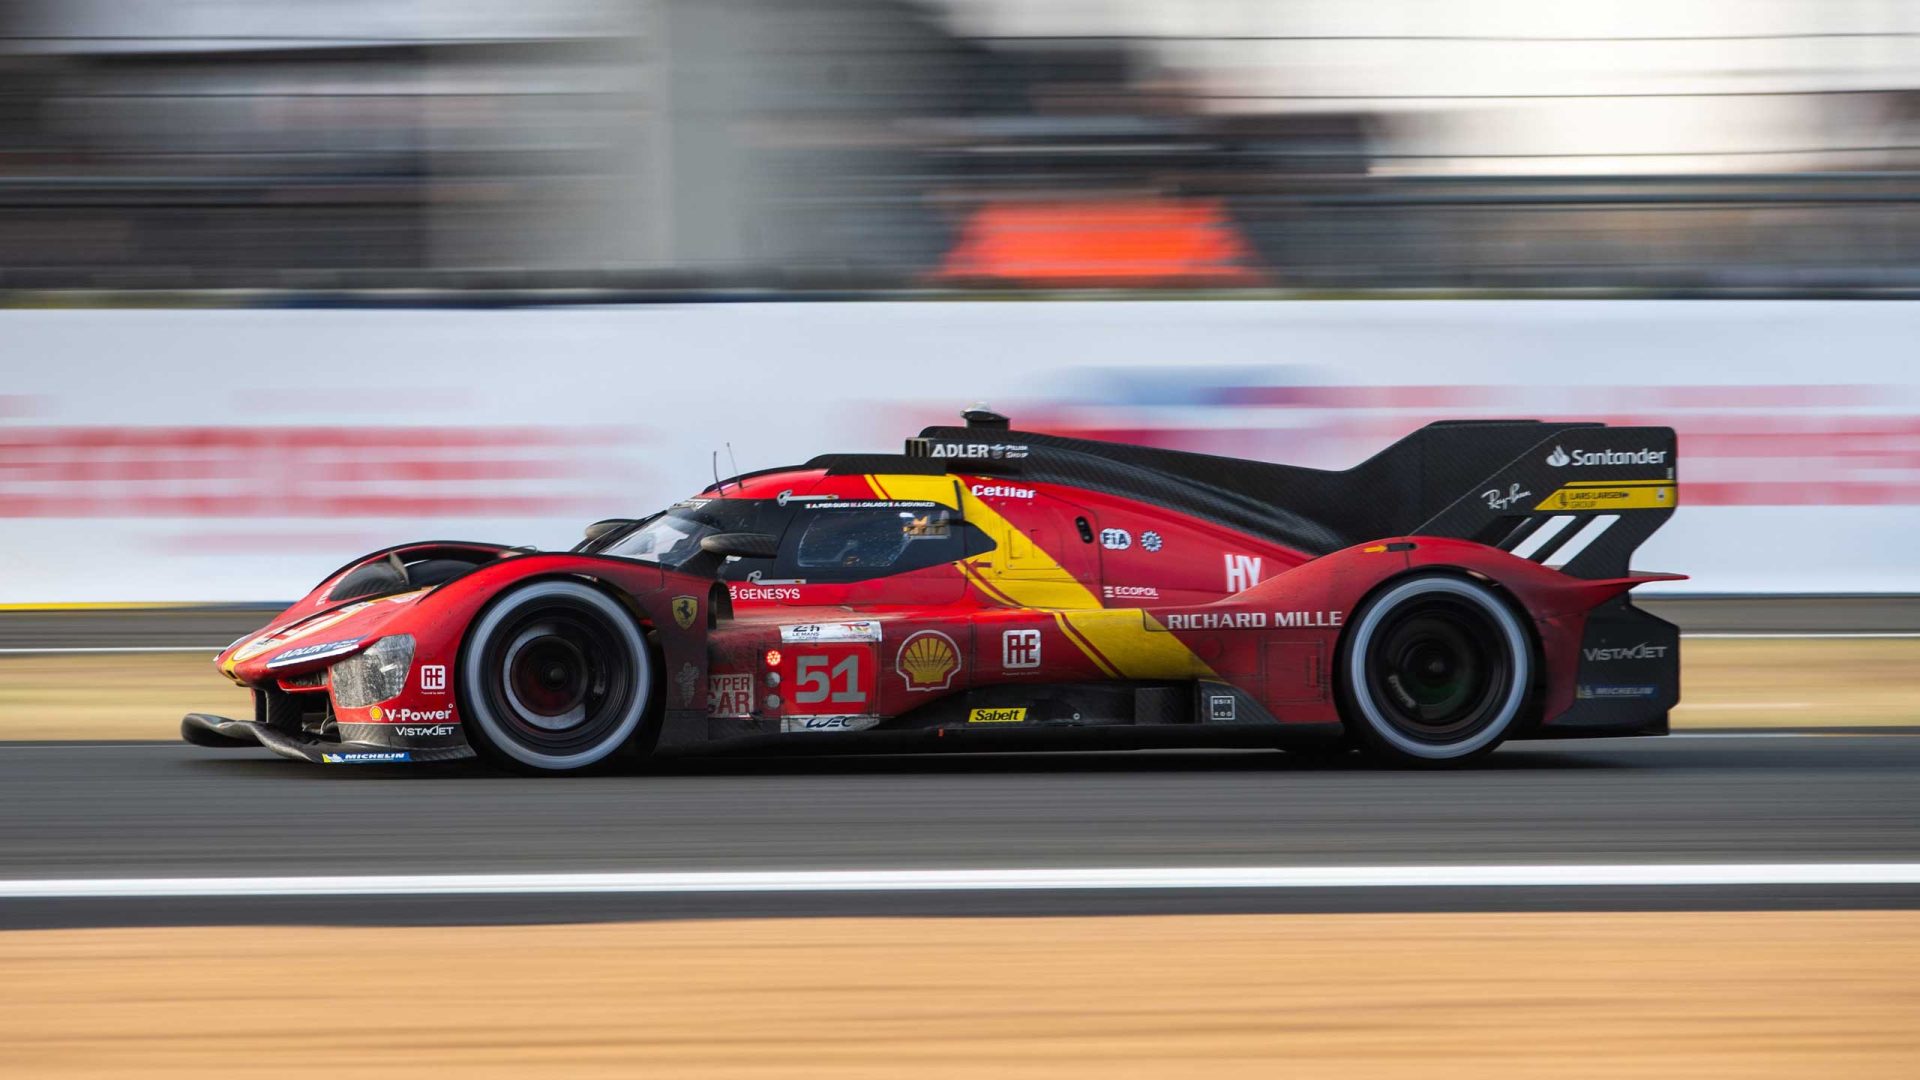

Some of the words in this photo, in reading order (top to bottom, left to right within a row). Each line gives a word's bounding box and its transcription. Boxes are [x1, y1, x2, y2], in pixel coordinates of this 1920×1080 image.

[931, 444, 989, 458] ADLER
[1571, 447, 1667, 466] Santander
[971, 484, 1036, 499] Cetilar
[1224, 554, 1262, 593] HY
[739, 588, 801, 600] GENESYS
[1115, 586, 1159, 596] ECOPOL
[1167, 612, 1267, 630] RICHARD
[1275, 611, 1343, 627] MILLE
[795, 654, 867, 704] 51
[385, 708, 452, 721] V-Power
[975, 709, 1020, 721] Sabelt
[806, 717, 852, 729] WEC
